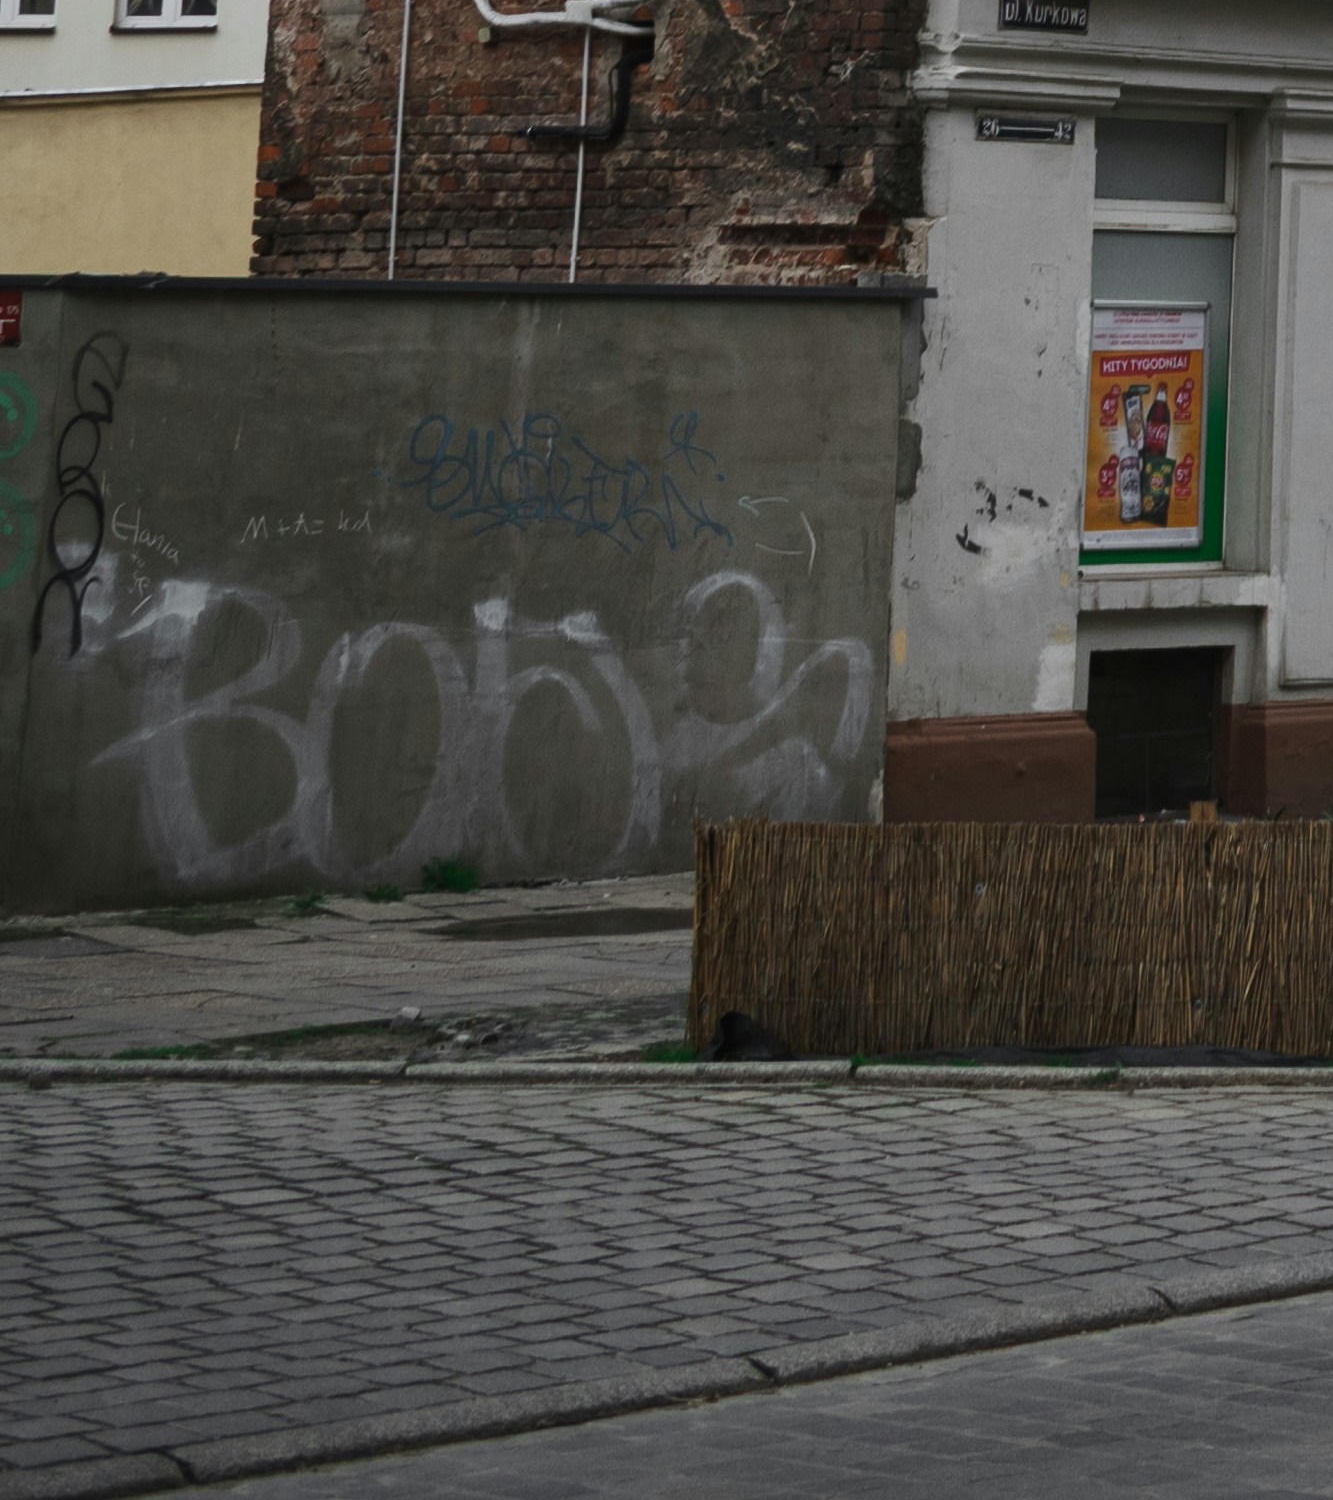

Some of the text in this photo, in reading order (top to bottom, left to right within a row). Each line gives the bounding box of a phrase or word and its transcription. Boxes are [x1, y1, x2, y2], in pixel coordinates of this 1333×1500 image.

[1025, 0, 1087, 26] Kurkowa
[982, 118, 1072, 140] 26 42
[1103, 356, 1188, 373] HITY TYGODNIA!
